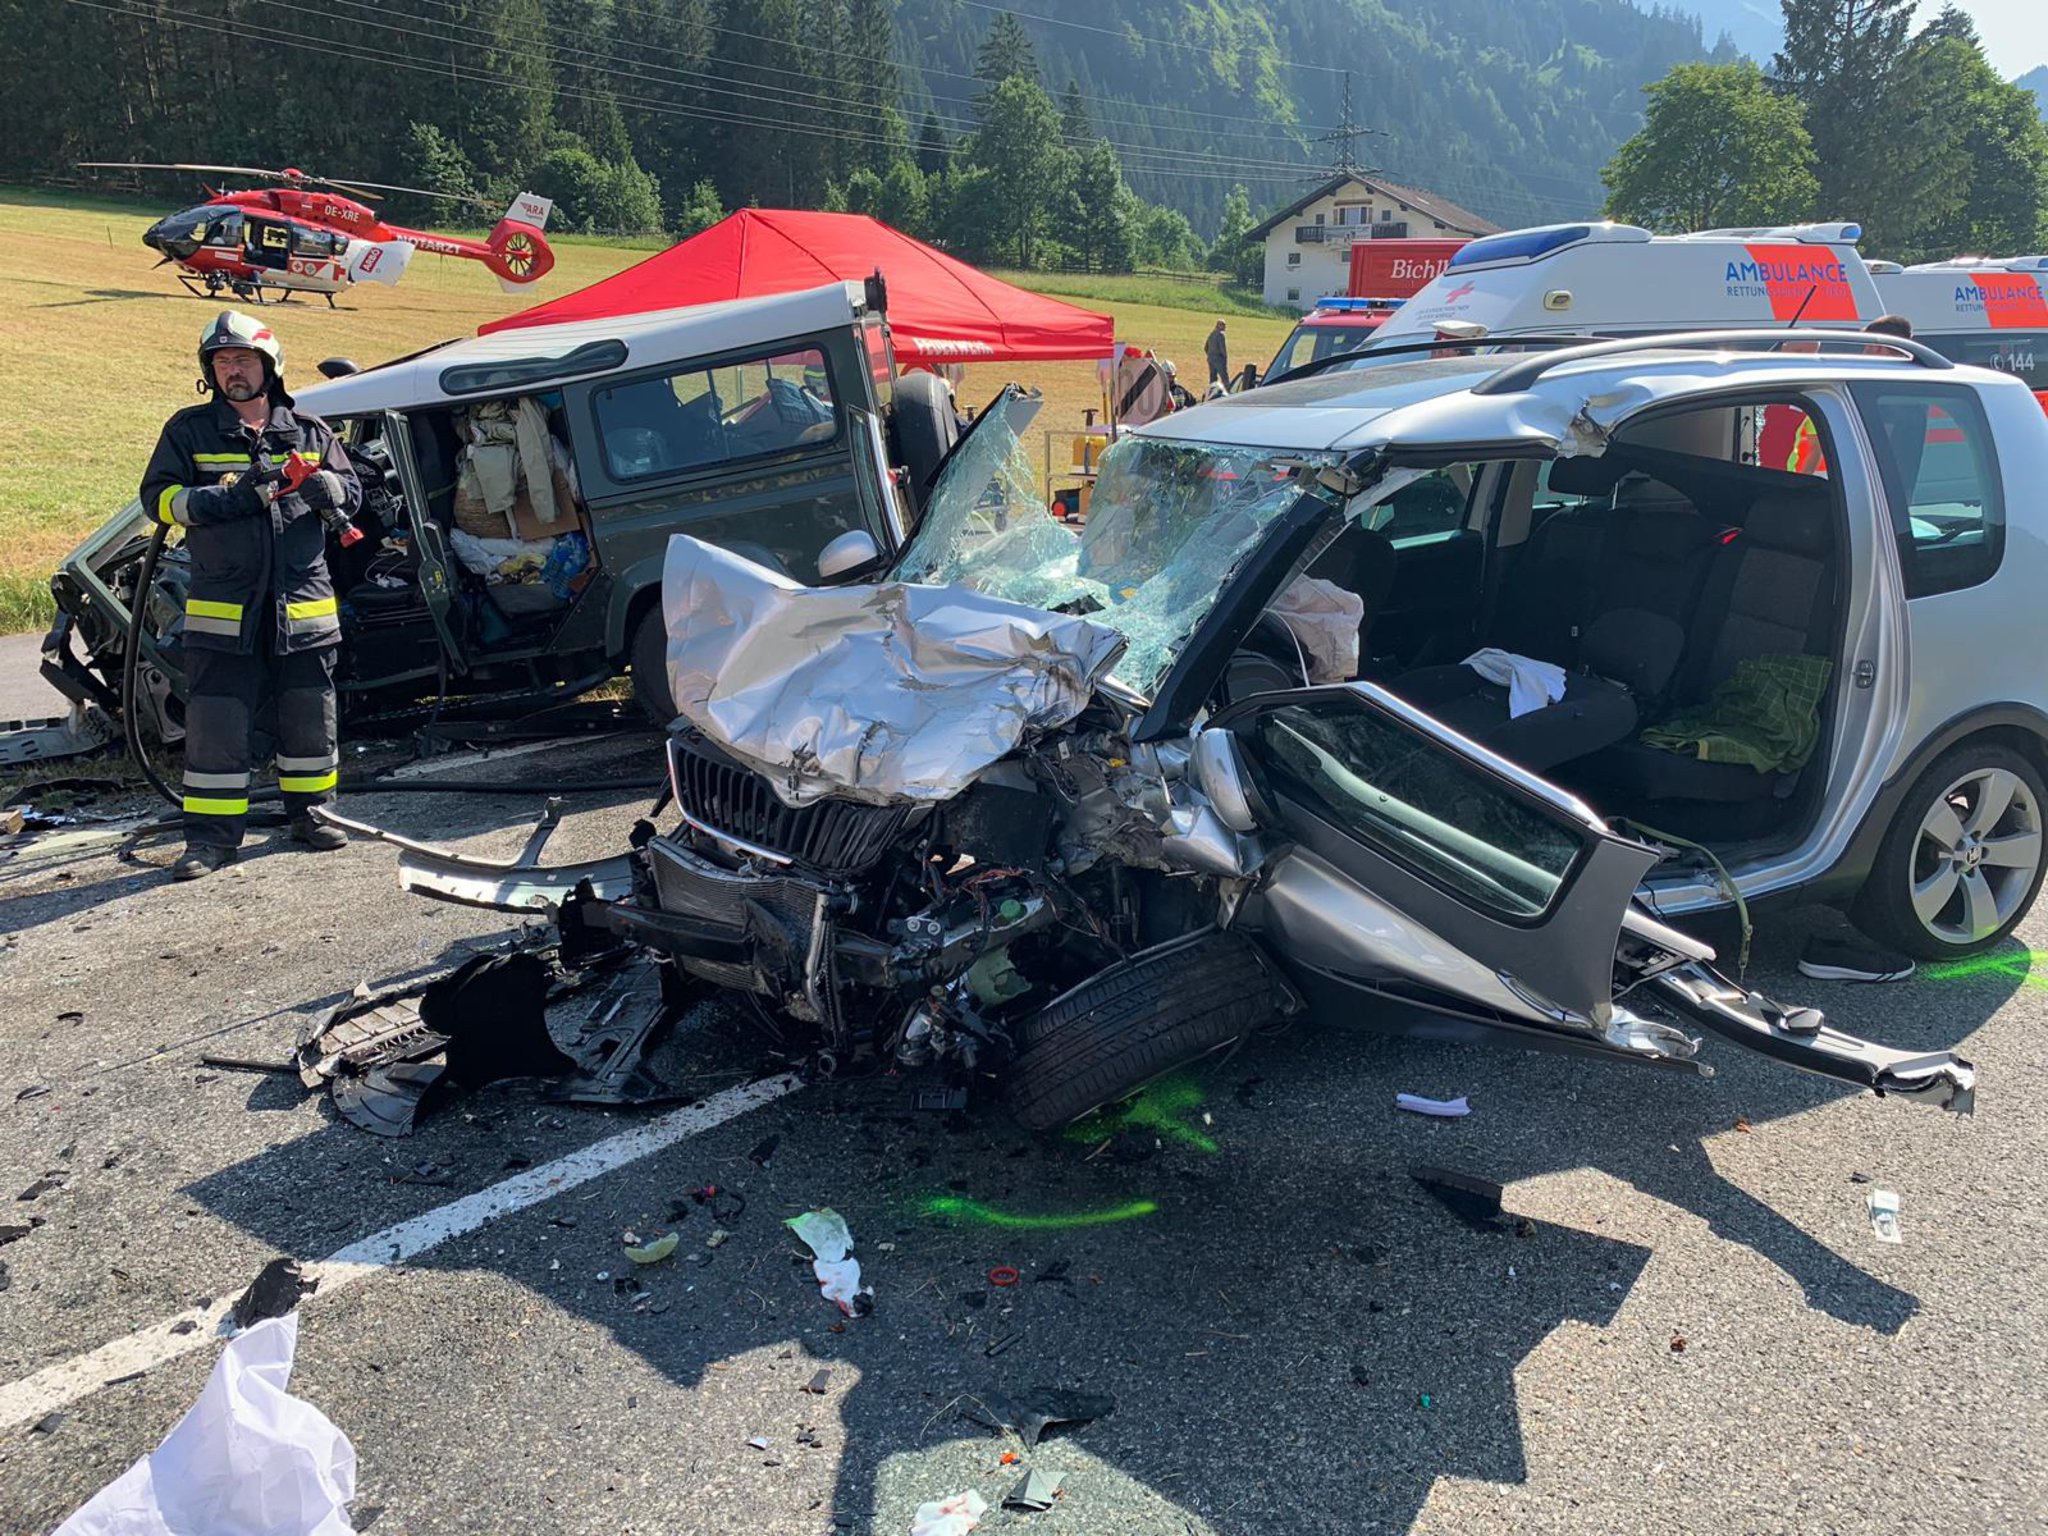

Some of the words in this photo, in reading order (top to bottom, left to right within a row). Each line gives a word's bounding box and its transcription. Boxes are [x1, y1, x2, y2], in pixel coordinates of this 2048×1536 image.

[1726, 261, 1848, 283] AMBULANCE
[1955, 286, 2044, 301] AMBULANCE
[912, 337, 993, 356] FEUERWEHR
[2007, 353, 2035, 372] 144
